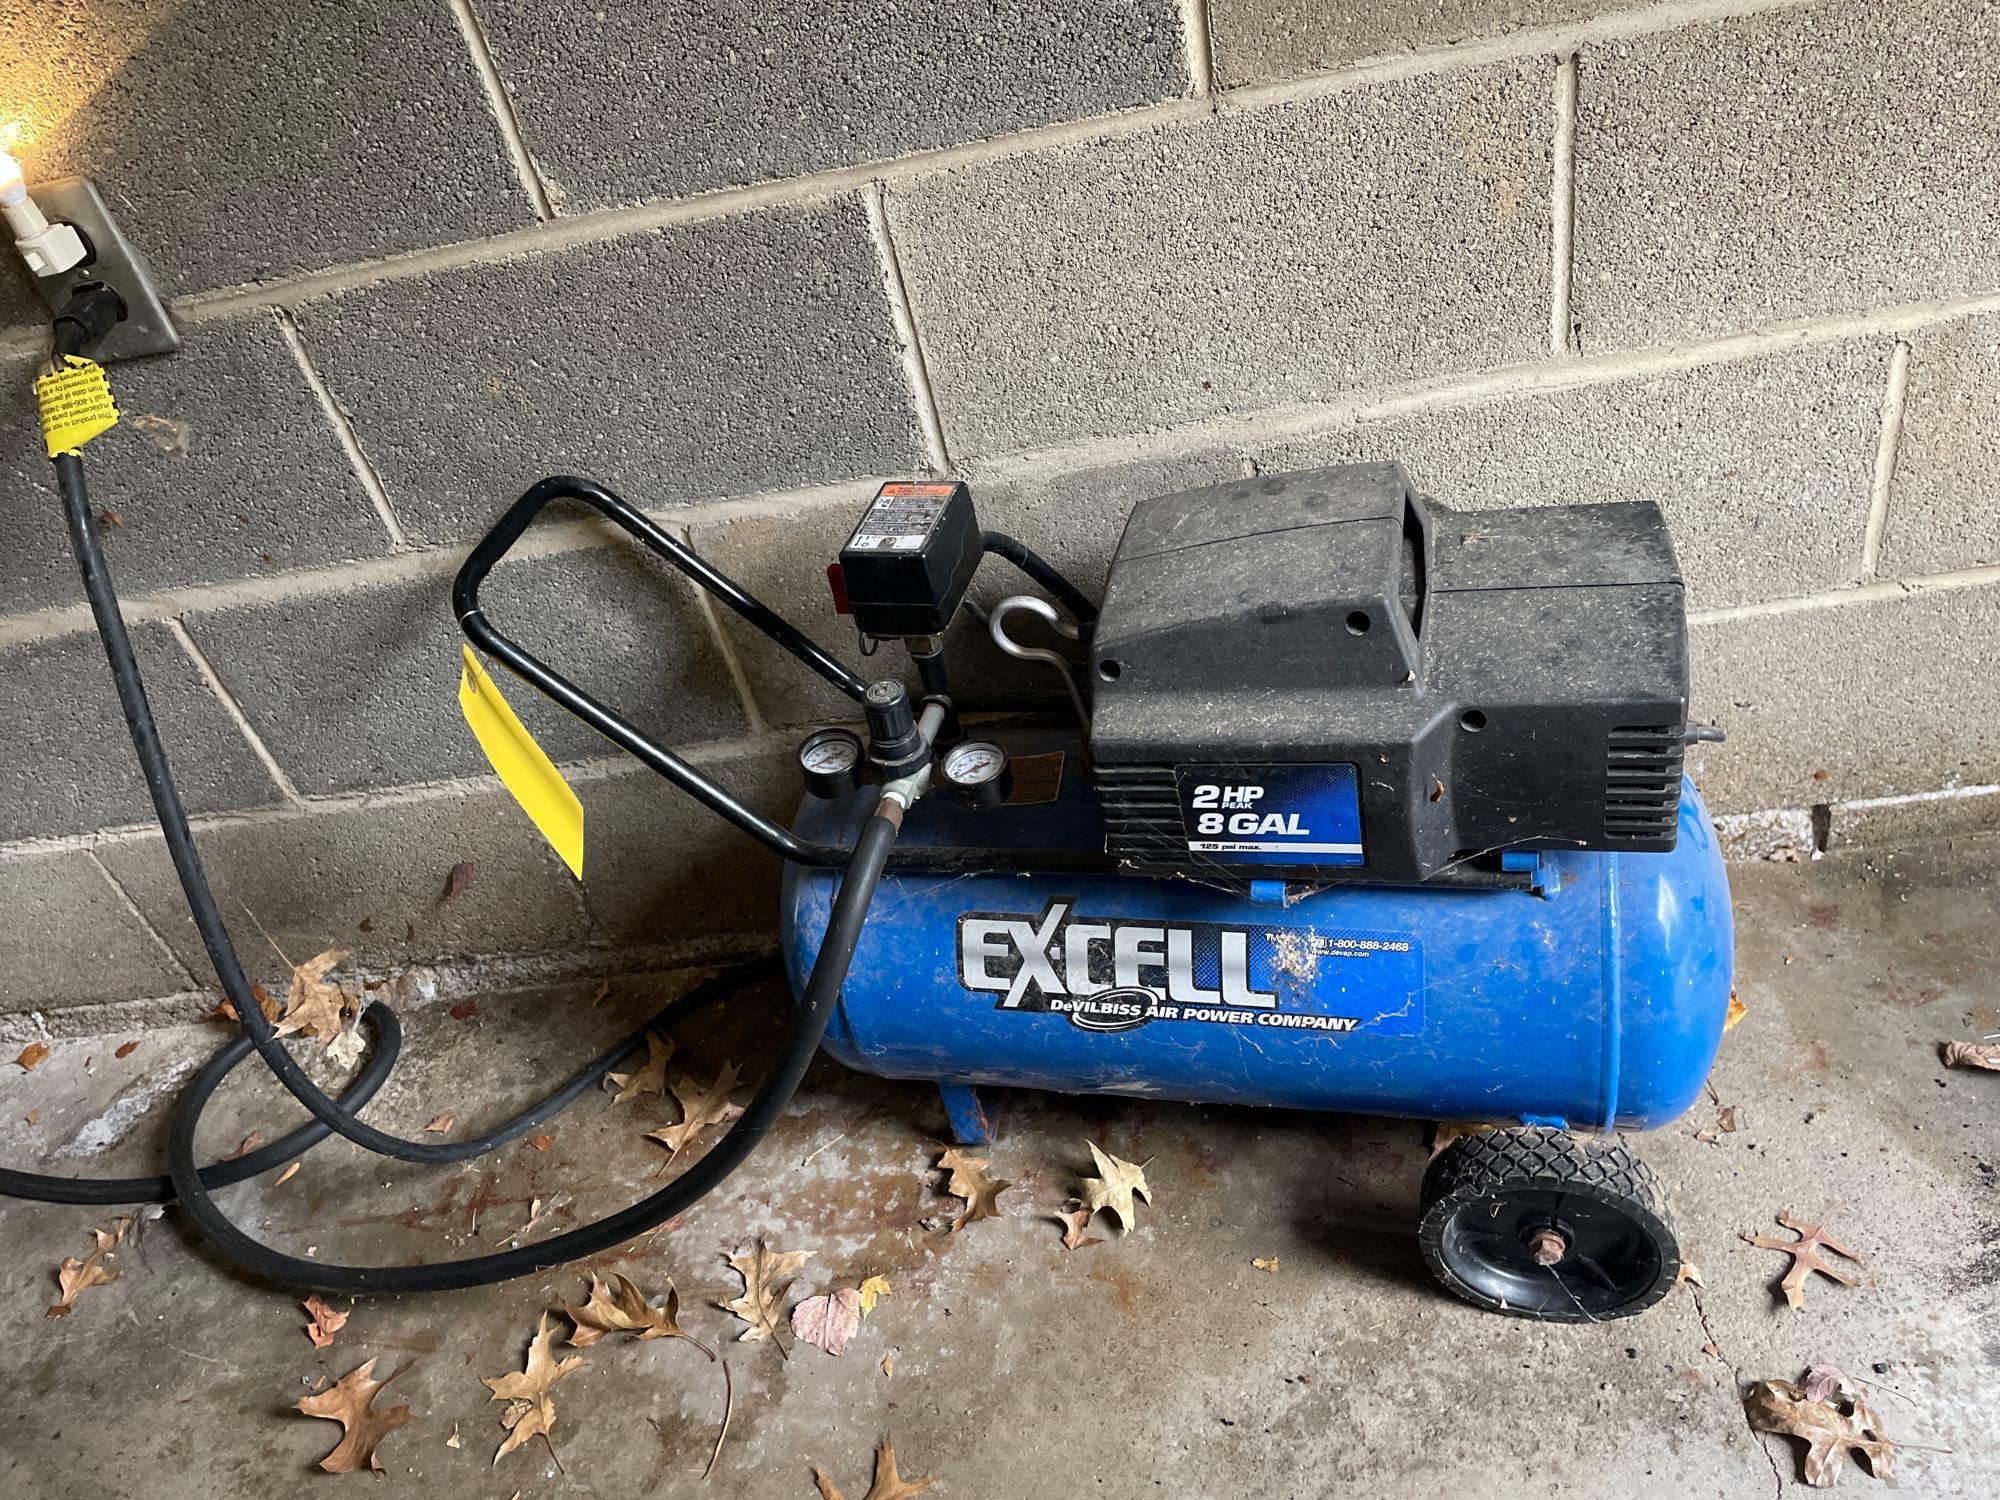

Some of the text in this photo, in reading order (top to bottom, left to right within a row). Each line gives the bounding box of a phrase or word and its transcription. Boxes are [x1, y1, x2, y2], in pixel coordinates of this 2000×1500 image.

[83, 366, 98, 376] your
[63, 379, 88, 390] covered
[65, 392, 71, 400] of
[51, 412, 68, 421] parts
[71, 415, 96, 425] product
[1192, 784, 1265, 809] 2 HP
[1221, 802, 1254, 810] PEAK
[1197, 812, 1310, 836] 8 GAL
[1221, 843, 1237, 852] psi
[1328, 939, 1409, 952] 1-800-888-2468
[1050, 998, 1359, 1033] DeVILBISS AIR POWER COMPANY
